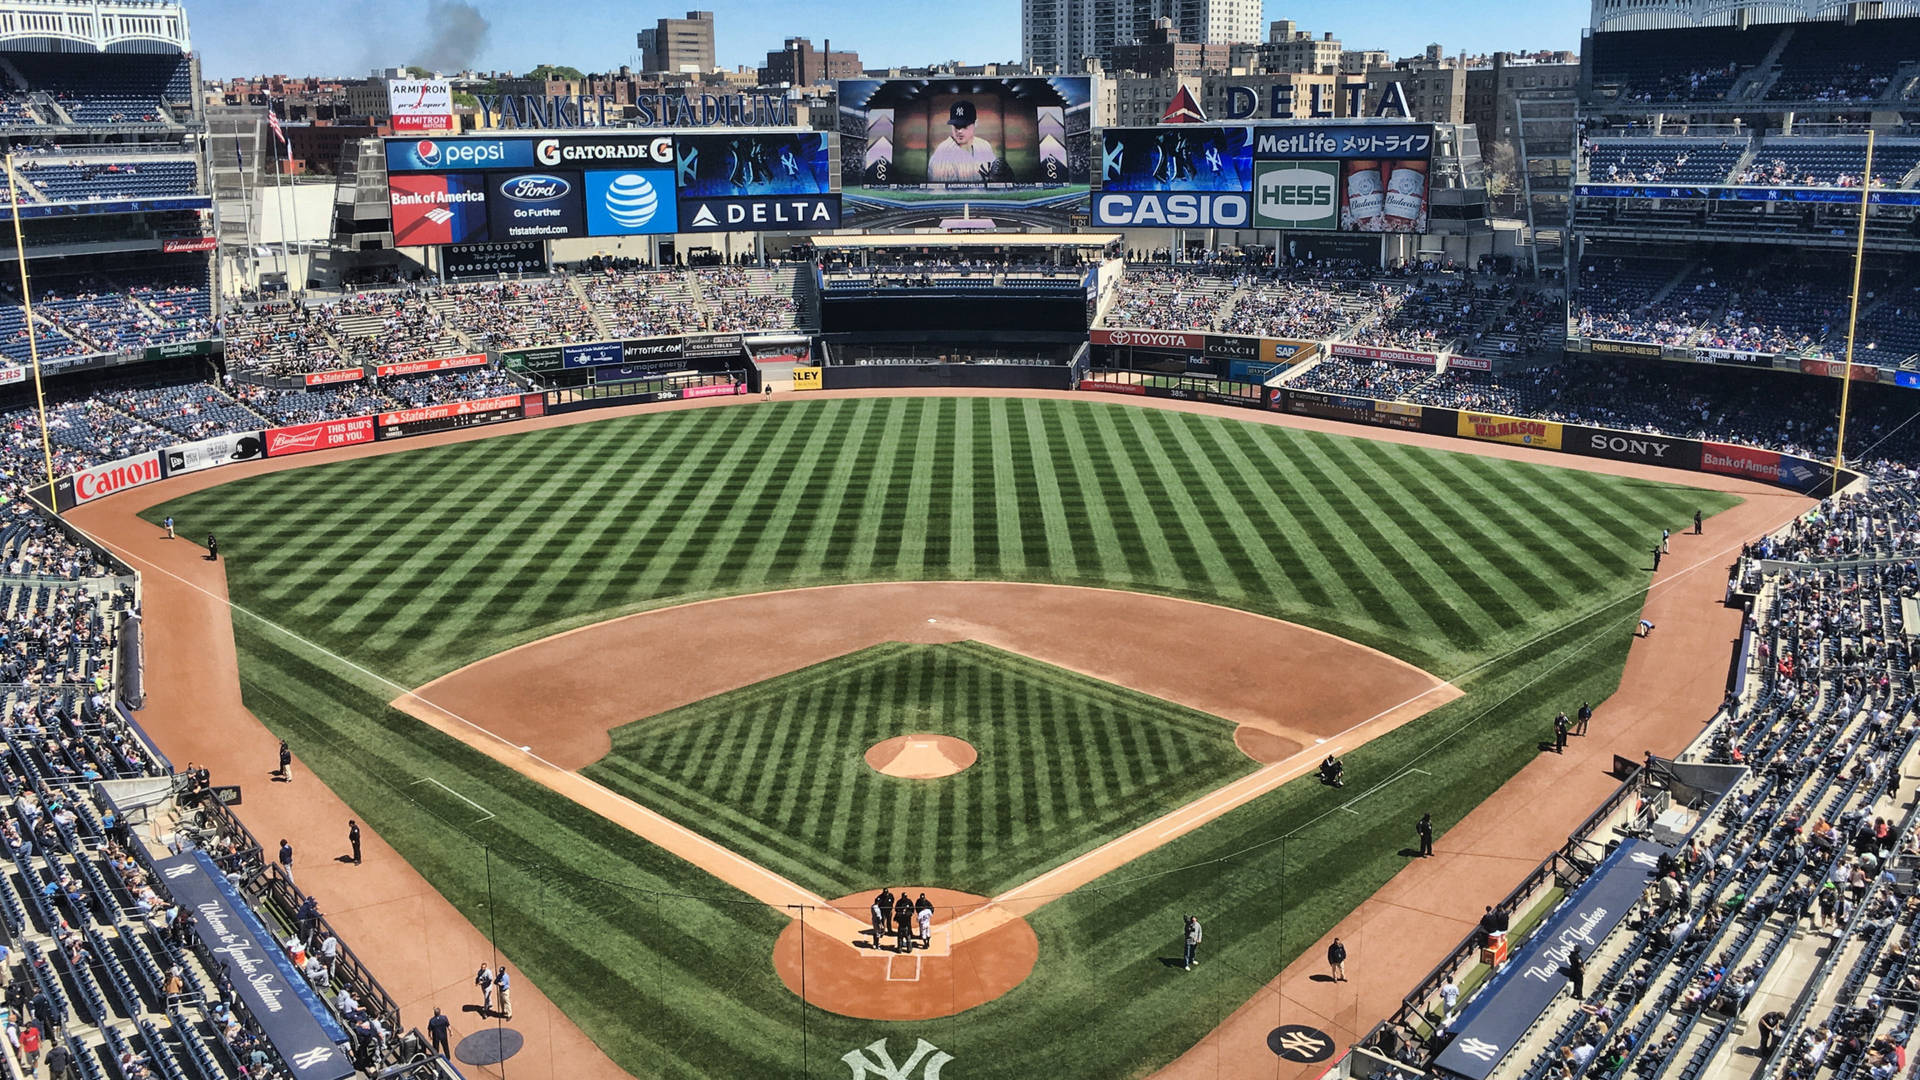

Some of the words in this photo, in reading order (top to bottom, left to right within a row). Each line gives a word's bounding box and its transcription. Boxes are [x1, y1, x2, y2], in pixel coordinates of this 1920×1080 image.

[393, 85, 447, 94] ARMITRON
[1228, 81, 1412, 119] DELTA
[477, 94, 616, 129] YANKEE
[638, 94, 791, 127] STADIUM
[399, 116, 447, 124] ARMITRON
[1257, 132, 1336, 153] MetLife
[1342, 135, 1430, 152] メットライフ
[446, 142, 504, 165] pepsi
[563, 145, 648, 159] GATORADE
[514, 179, 556, 198] Ford
[1262, 185, 1331, 206] HESS
[392, 192, 422, 205] Bank
[423, 191, 437, 203] of
[436, 190, 484, 203] America
[514, 209, 527, 218] Go
[528, 208, 561, 218] Further
[727, 202, 831, 224] DELTA
[1099, 194, 1246, 225] CASIO
[509, 225, 568, 236] tristateford.com
[166, 240, 216, 252] Budweiser
[1132, 333, 1186, 347] TOYOTA
[1209, 345, 1254, 355] COACH
[1276, 346, 1295, 357] SAP
[1334, 346, 1367, 357] MODELL'S
[1380, 351, 1432, 363] MODELLS.com
[1611, 345, 1660, 356] BUSINESS
[1189, 355, 1210, 365] FedEx
[1452, 359, 1488, 369] MODELL'S
[1348, 398, 1367, 407] pepsi
[327, 424, 346, 434] THIS
[348, 419, 372, 431] BUD'S
[275, 432, 321, 447] Budweiser
[328, 434, 345, 444] FOR
[346, 431, 366, 442] YOU.
[1591, 434, 1670, 457] SONY
[1704, 453, 1733, 467] Bank
[1733, 458, 1745, 469] of
[1745, 459, 1787, 478] America
[76, 458, 160, 500] Canon
[197, 900, 229, 936] Welcome
[220, 933, 239, 944] to
[1523, 960, 1560, 983] New
[1543, 936, 1579, 966] York
[1562, 907, 1607, 945] Yankees
[213, 939, 264, 975] Yankee
[248, 973, 283, 1012] Stadium
